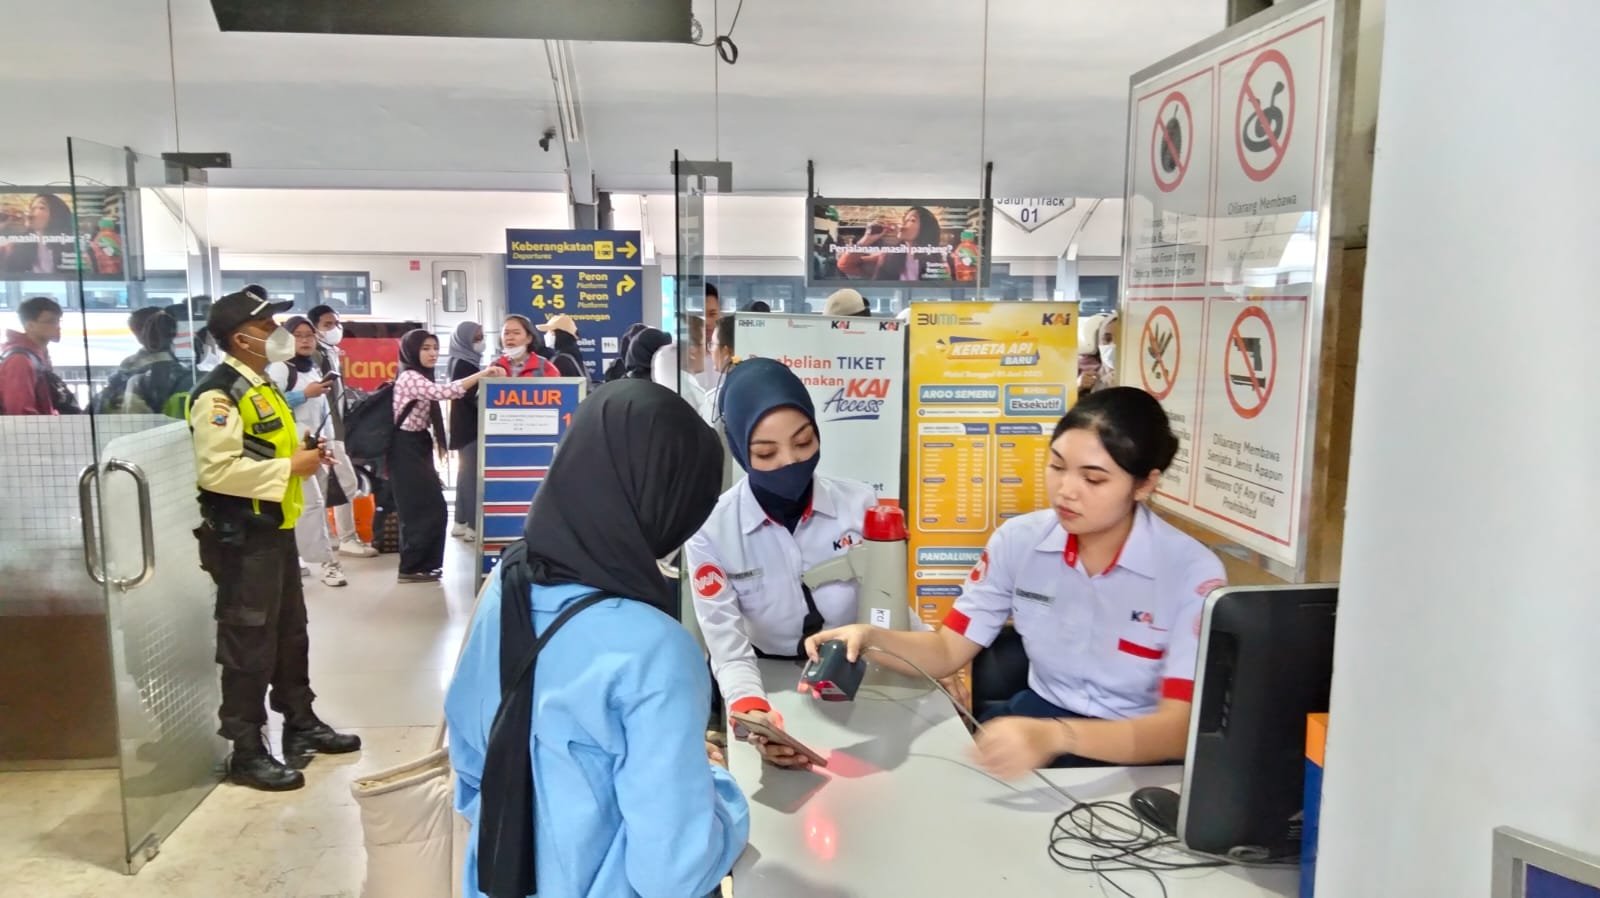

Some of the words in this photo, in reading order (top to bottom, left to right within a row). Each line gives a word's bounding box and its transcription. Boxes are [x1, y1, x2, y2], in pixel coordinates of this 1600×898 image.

[1259, 194, 1297, 209] Membawa
[1021, 208, 1038, 223] 01
[511, 241, 594, 254] Keberangkatan
[829, 244, 880, 254] Perjalanan
[881, 244, 910, 254] masih
[911, 244, 953, 255] panjang?
[578, 272, 609, 282] Peron
[579, 291, 609, 301] Peron
[576, 338, 596, 346] oilet
[951, 342, 1005, 356] KERETA
[1006, 341, 1033, 354] API
[836, 356, 886, 370] TIKET
[1004, 356, 1034, 365] BARU
[845, 378, 890, 399] KAI
[921, 389, 953, 399] ARGO
[955, 389, 997, 399] SEMERU
[493, 389, 562, 406] JALUR
[823, 387, 885, 413] Access
[1011, 399, 1060, 410] Eksekutif
[1212, 432, 1242, 455] Dilarang
[1244, 440, 1281, 463] Membawa
